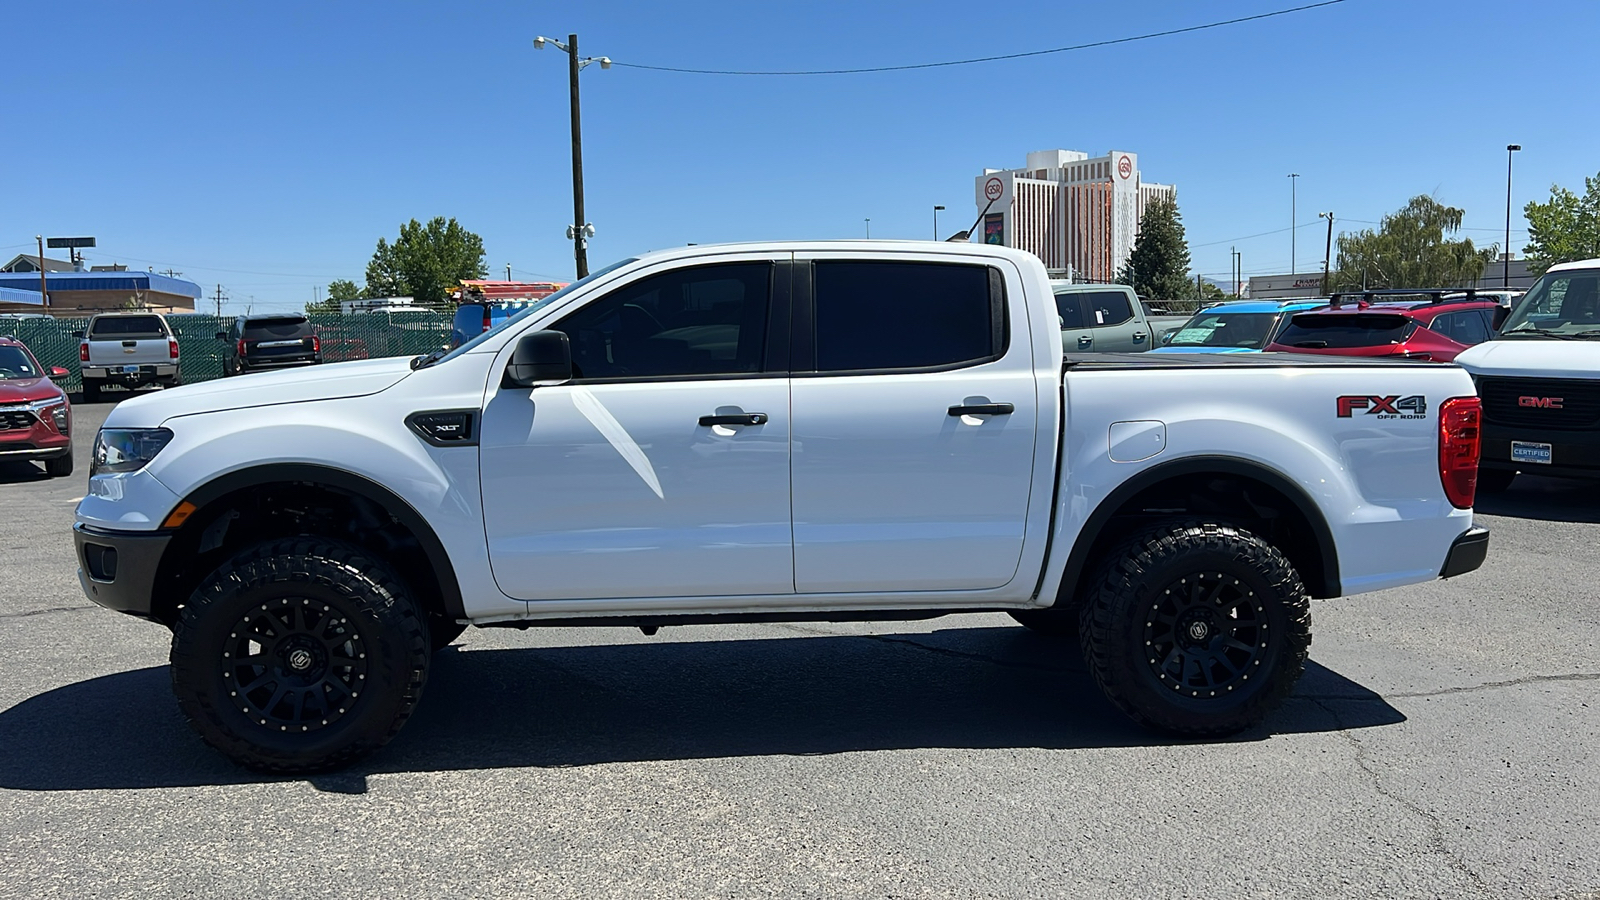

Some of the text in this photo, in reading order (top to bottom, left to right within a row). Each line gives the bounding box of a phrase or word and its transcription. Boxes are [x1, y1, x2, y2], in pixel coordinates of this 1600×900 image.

[1336, 395, 1427, 418] FX4
[1518, 396, 1564, 409] GMC
[1513, 448, 1550, 457] CERTIFIED
